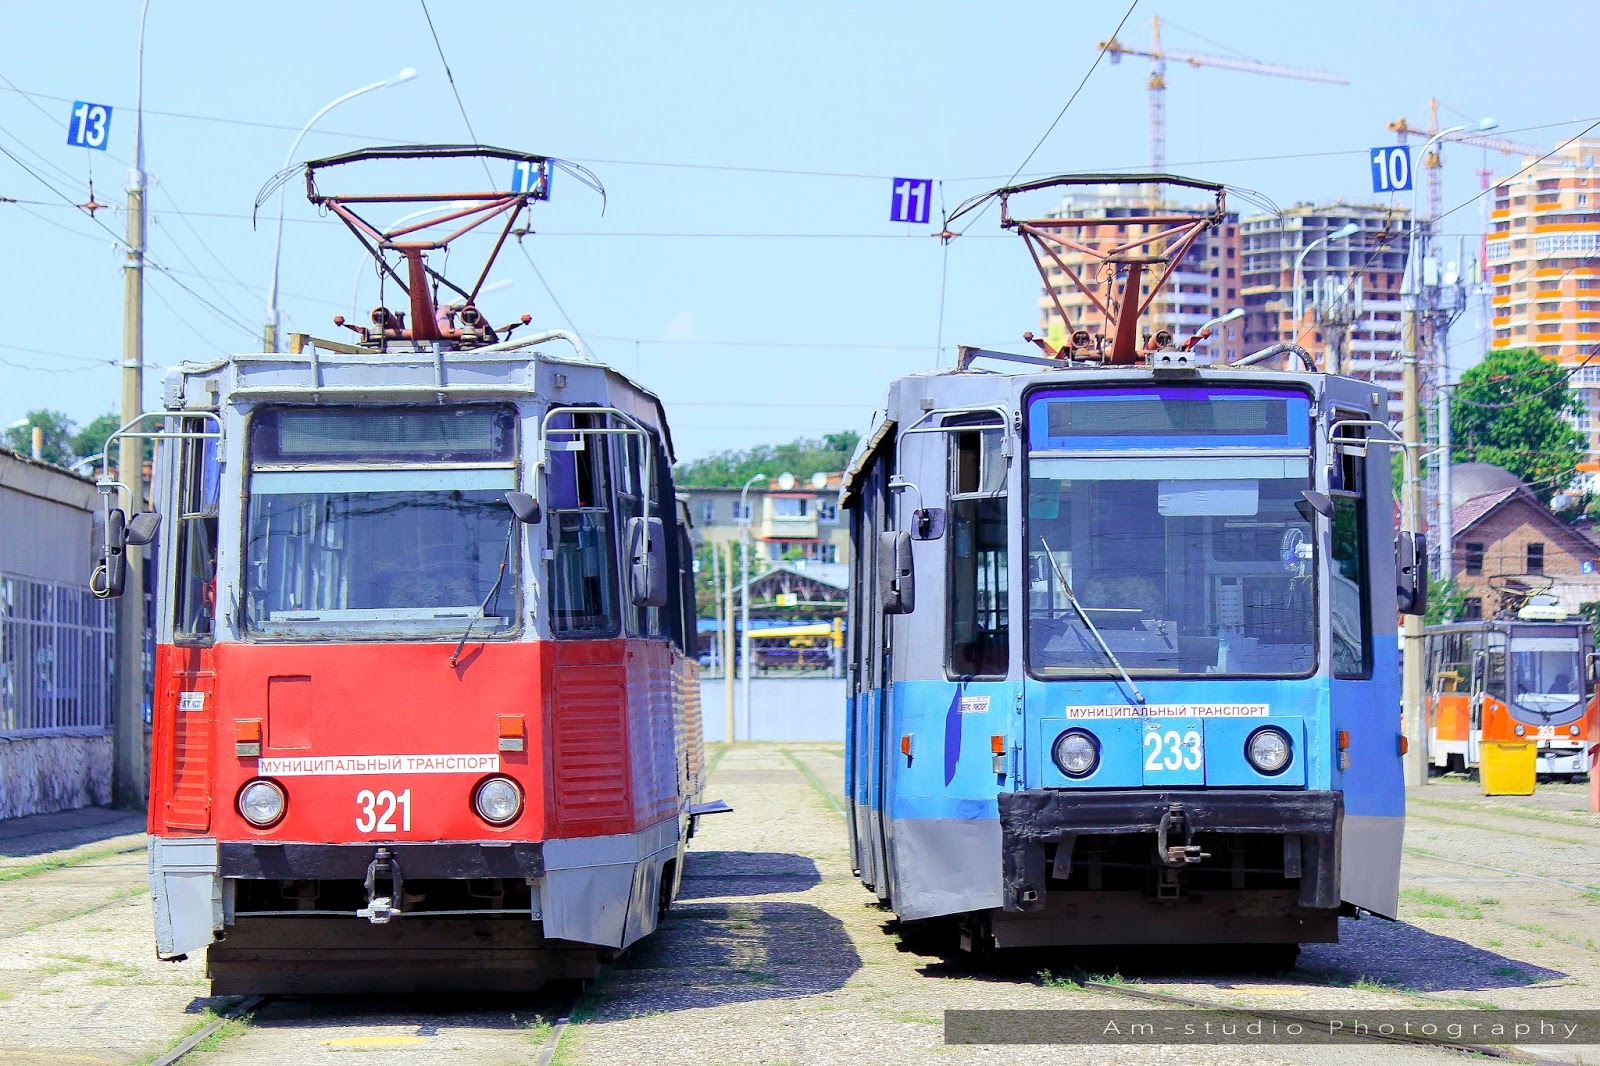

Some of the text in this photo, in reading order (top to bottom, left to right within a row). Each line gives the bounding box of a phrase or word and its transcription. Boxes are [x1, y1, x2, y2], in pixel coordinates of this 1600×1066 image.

[75, 103, 106, 147] 13
[1373, 148, 1408, 189] 10
[895, 181, 926, 221] 11
[1069, 705, 1265, 718] МУНИЦИПАЛЬНЫЙ ТРАНСПОРТ
[261, 757, 497, 774] МУНИЦИПАЛЬНЫЙ ТРАНСПОРТ
[1143, 731, 1201, 771] 233
[355, 788, 411, 833] 321
